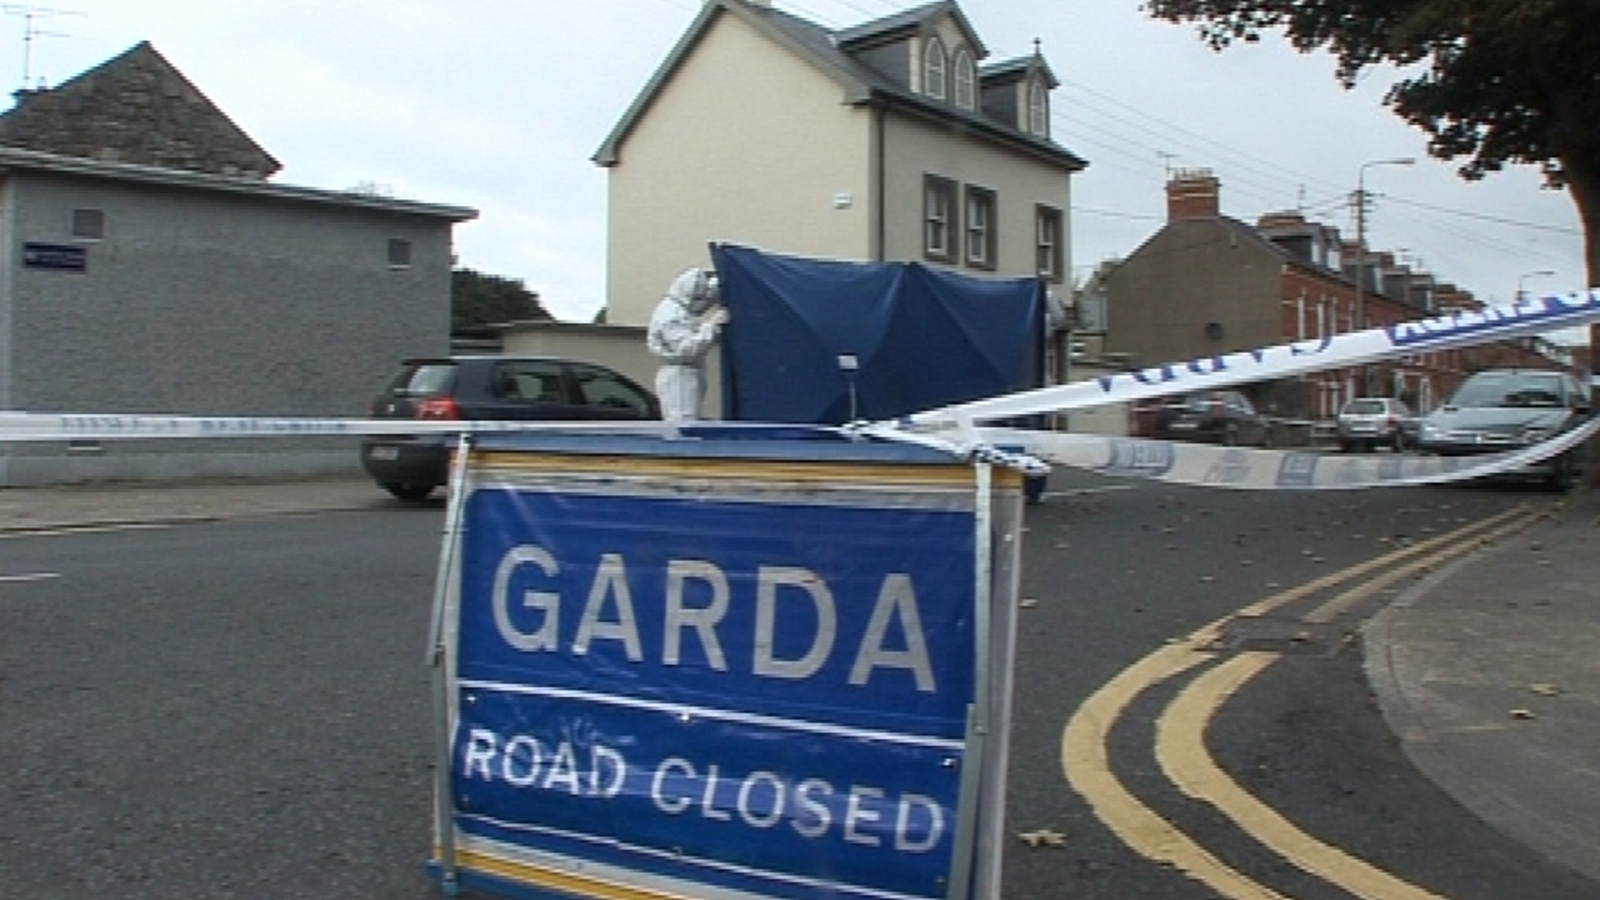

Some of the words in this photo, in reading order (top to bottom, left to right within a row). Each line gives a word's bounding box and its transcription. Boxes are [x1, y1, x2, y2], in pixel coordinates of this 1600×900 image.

[492, 544, 937, 693] GARDA
[463, 728, 627, 799] ROAD
[650, 757, 946, 854] CLOSED
